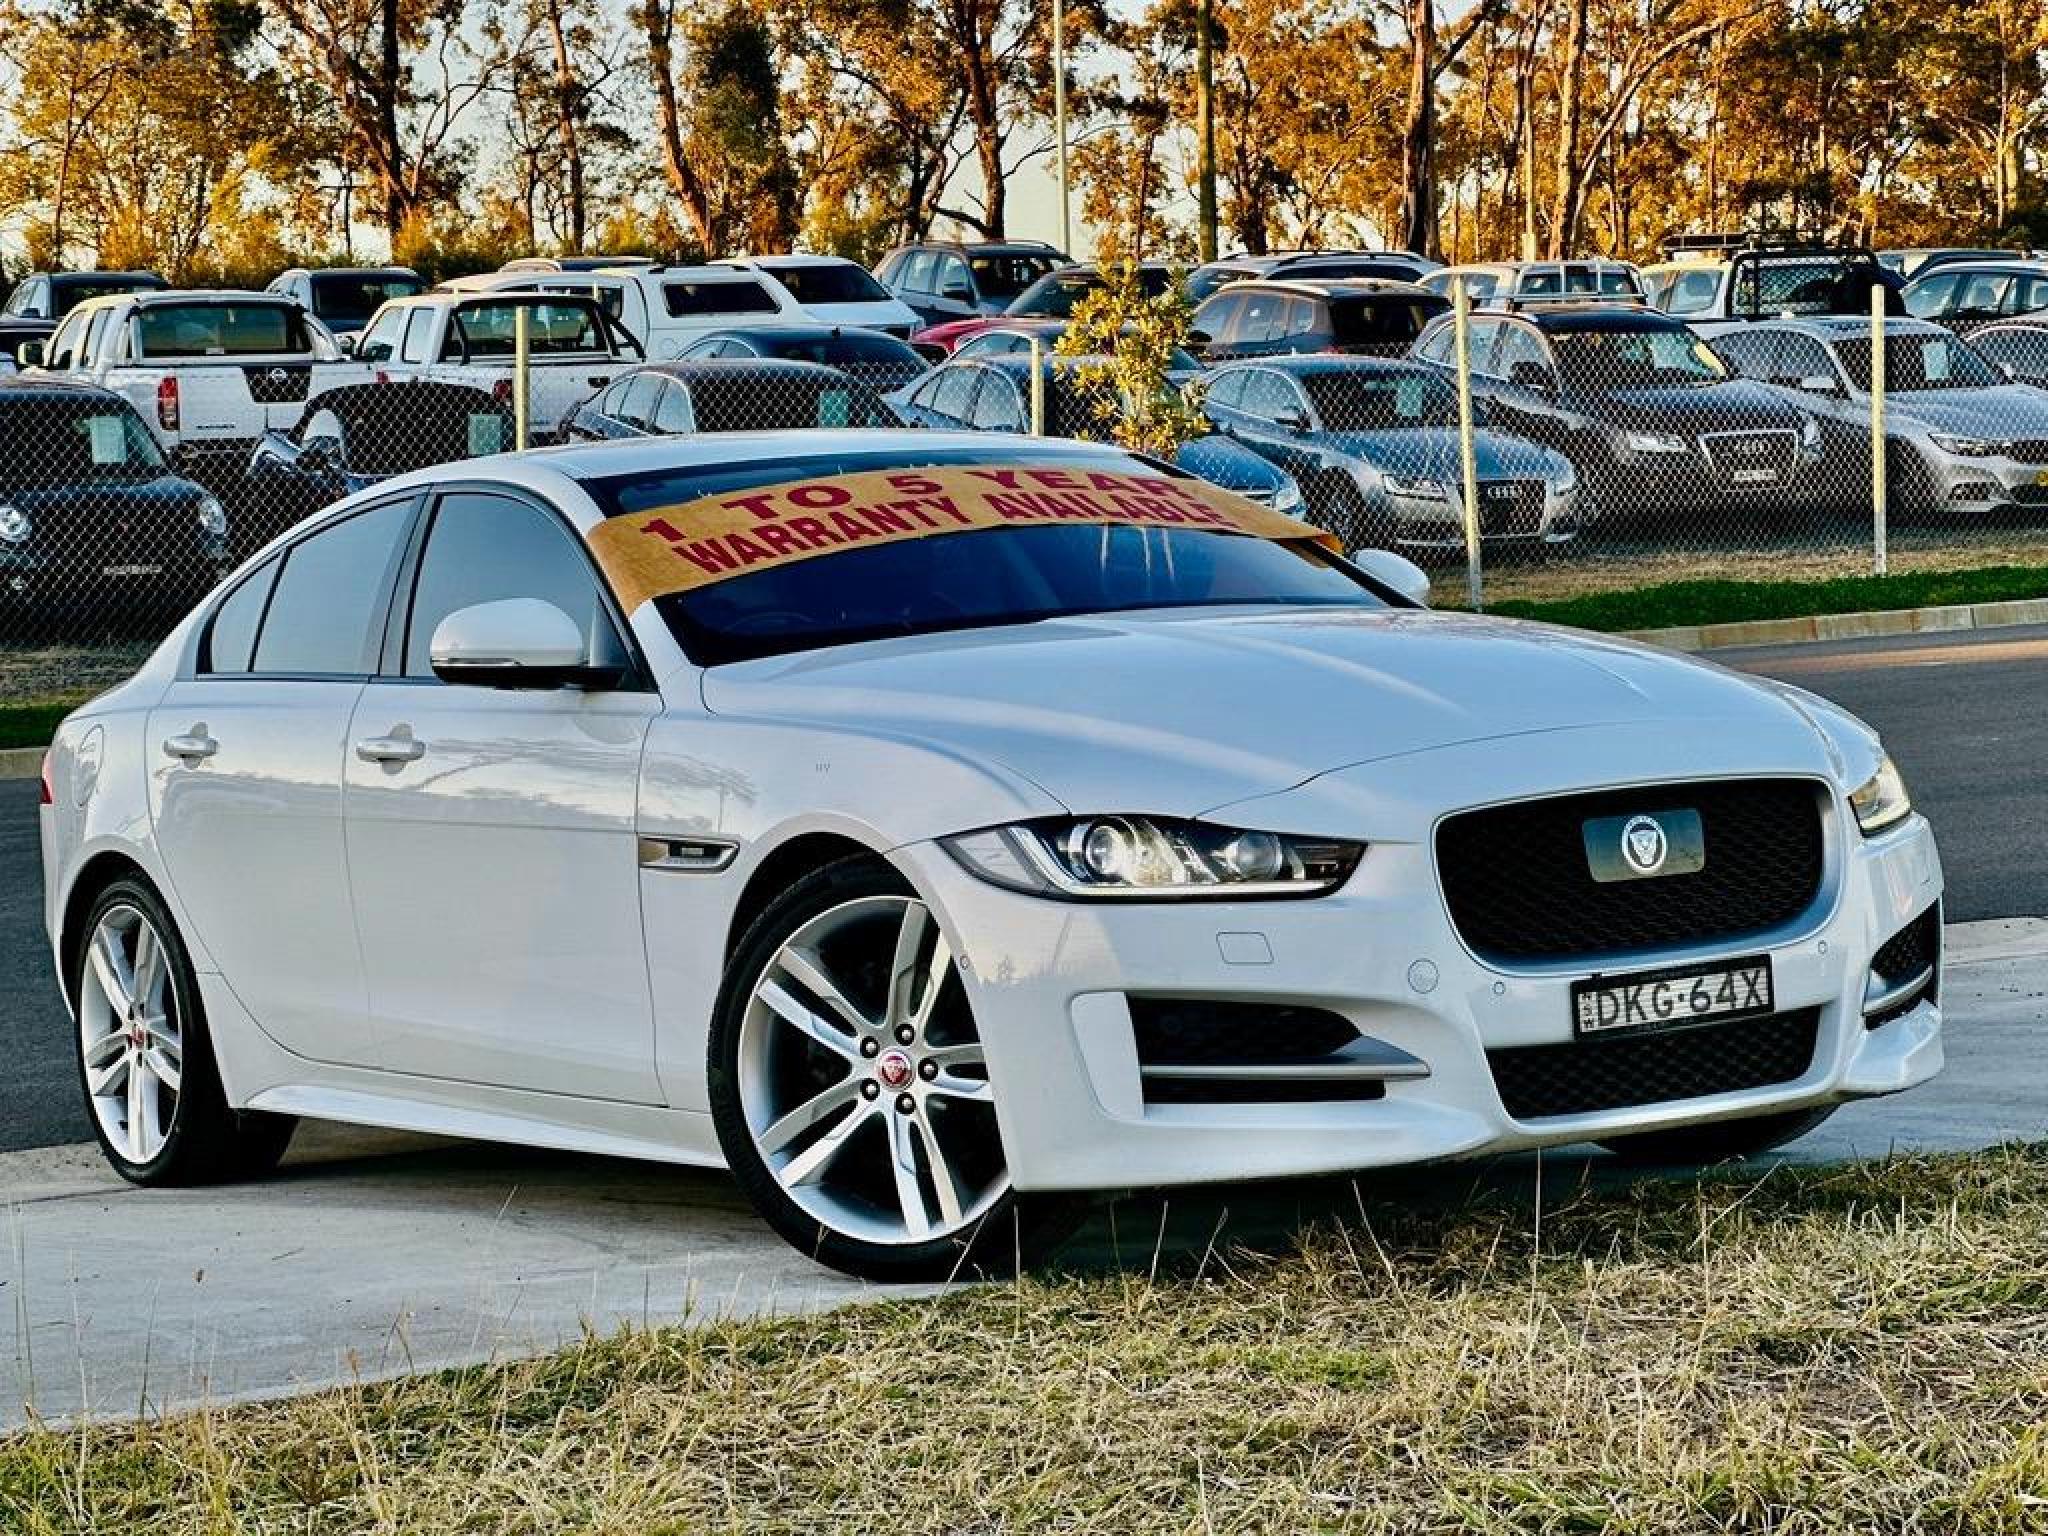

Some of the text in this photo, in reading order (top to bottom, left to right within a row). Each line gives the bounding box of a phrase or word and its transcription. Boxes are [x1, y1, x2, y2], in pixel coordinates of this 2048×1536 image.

[640, 470, 1195, 543] 1 TO 5 YEAR
[671, 493, 1242, 575] WARRANTY AVAILABLE
